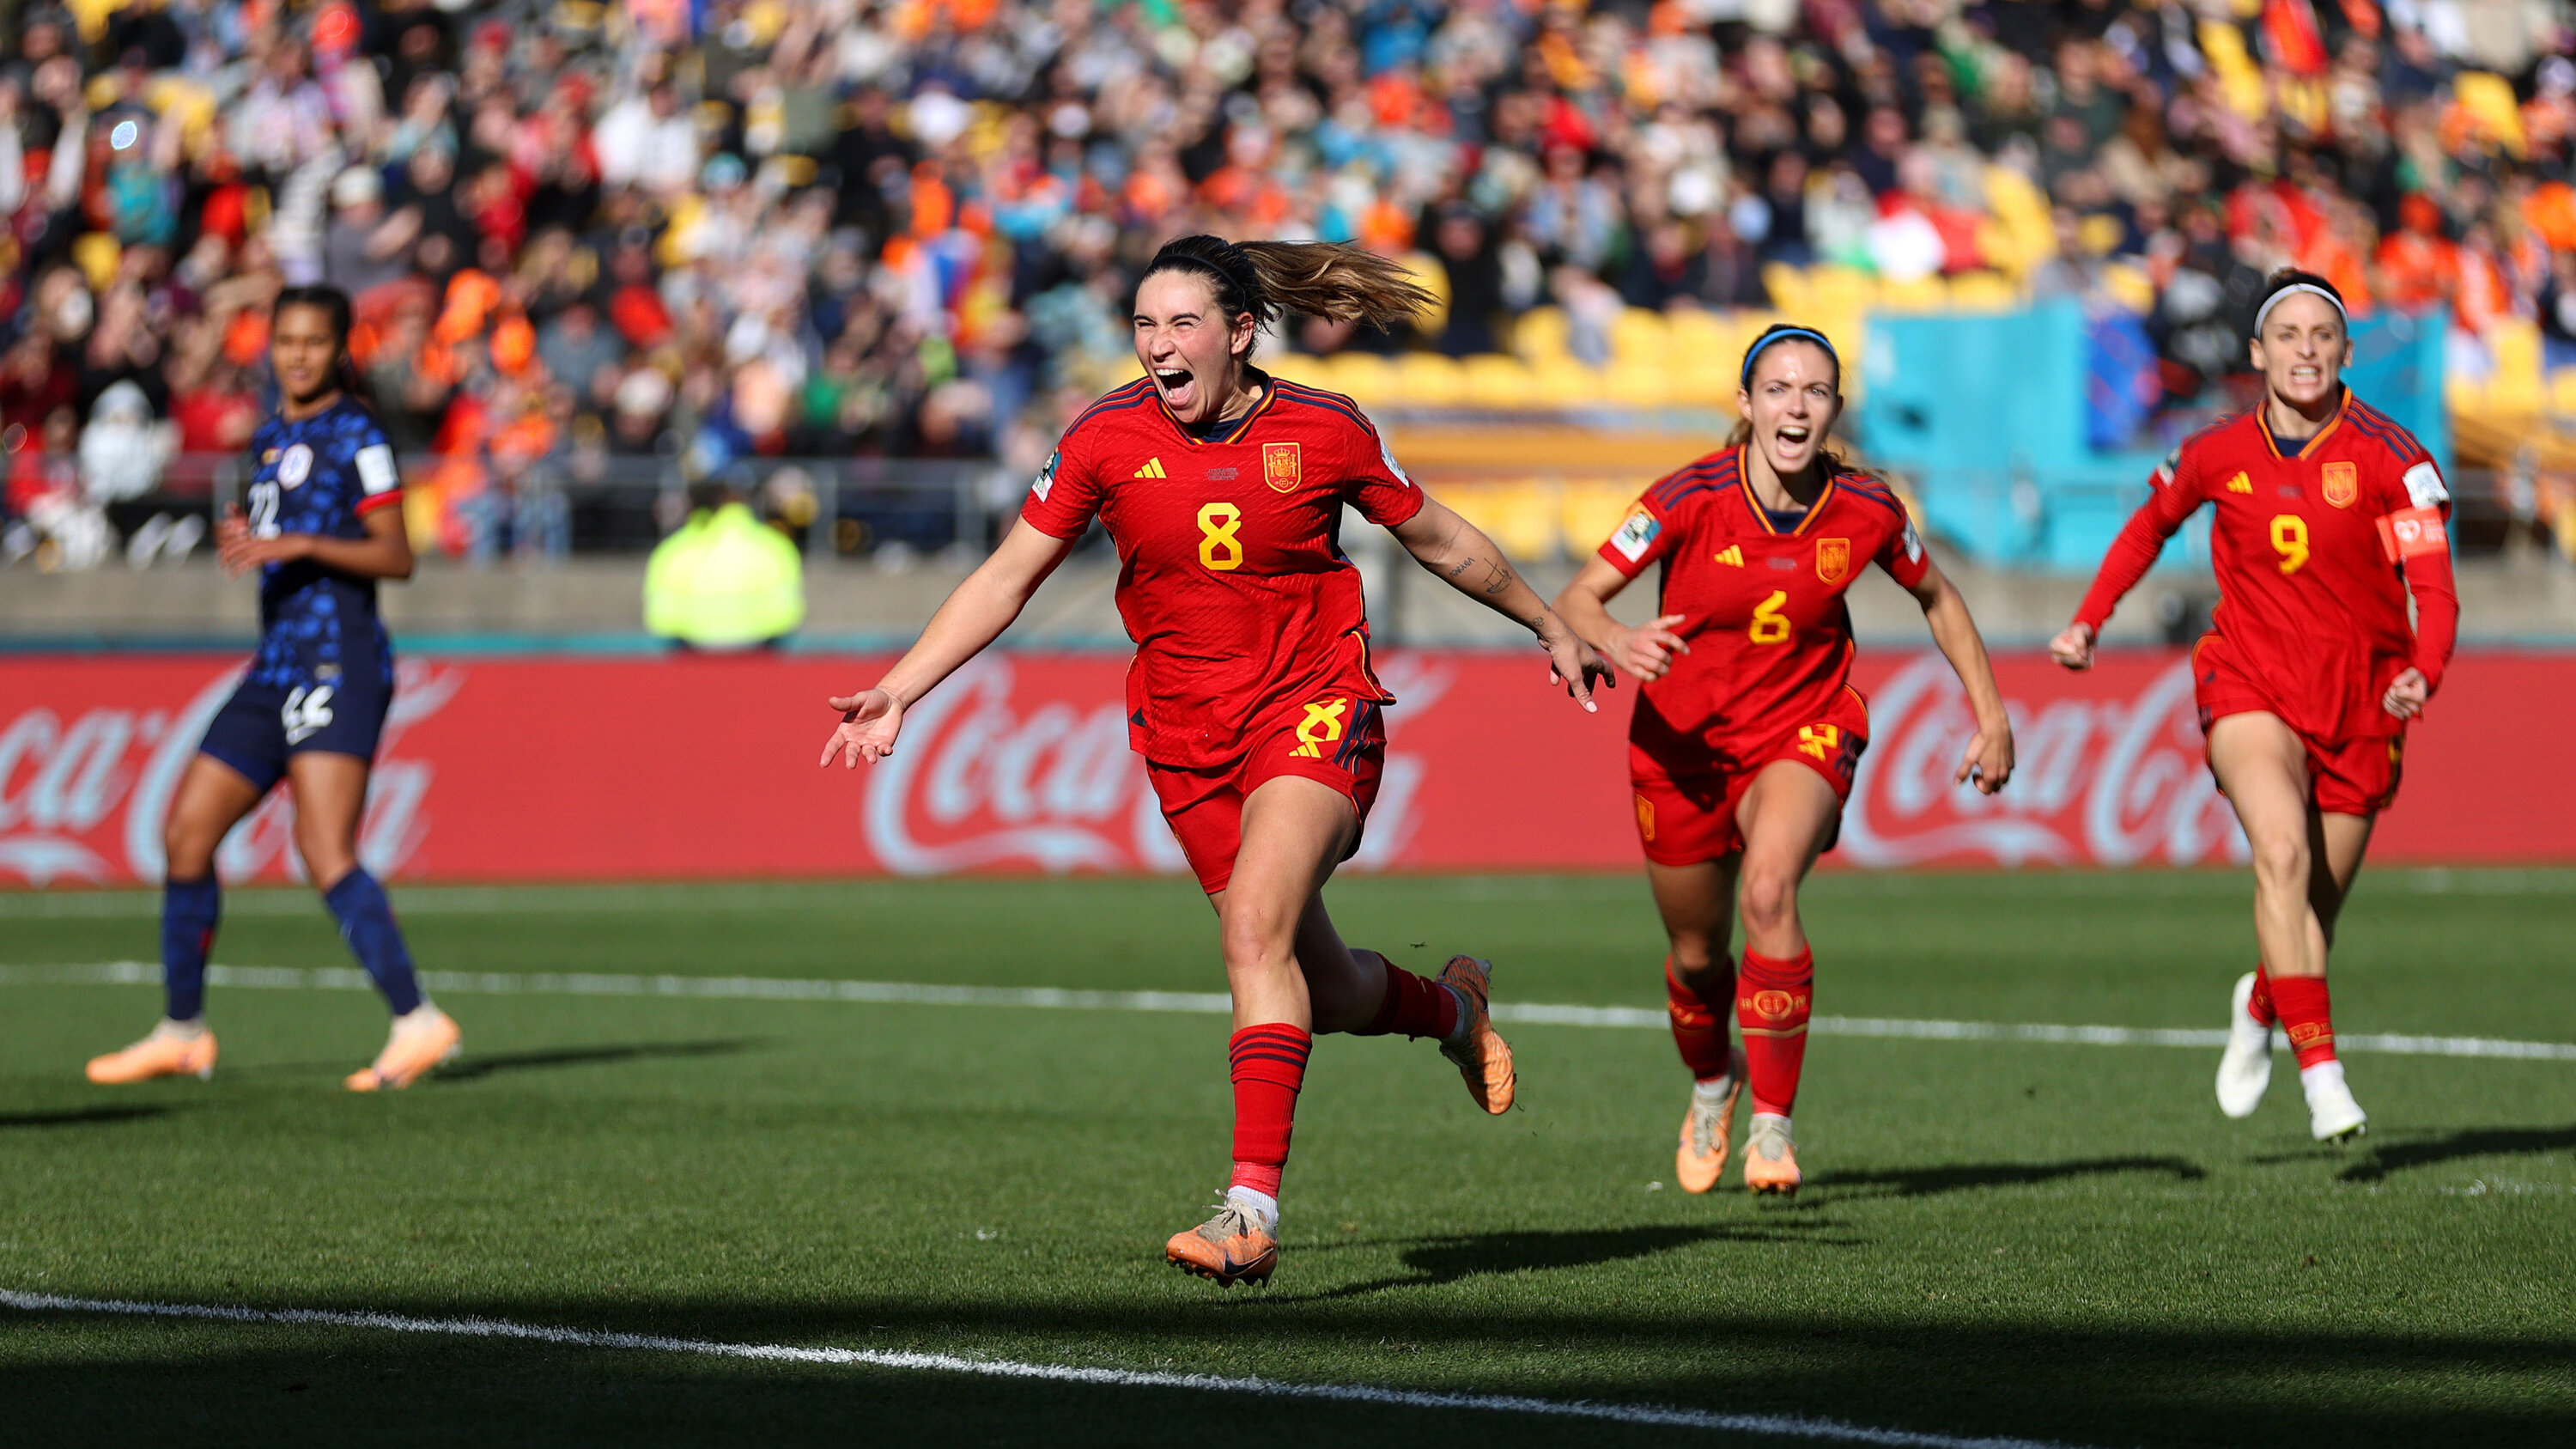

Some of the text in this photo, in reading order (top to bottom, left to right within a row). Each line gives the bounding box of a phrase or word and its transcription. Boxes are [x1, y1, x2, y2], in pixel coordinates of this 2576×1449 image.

[1197, 502, 1242, 570] 8
[2269, 514, 2310, 574] 9
[1748, 590, 1791, 644] 6
